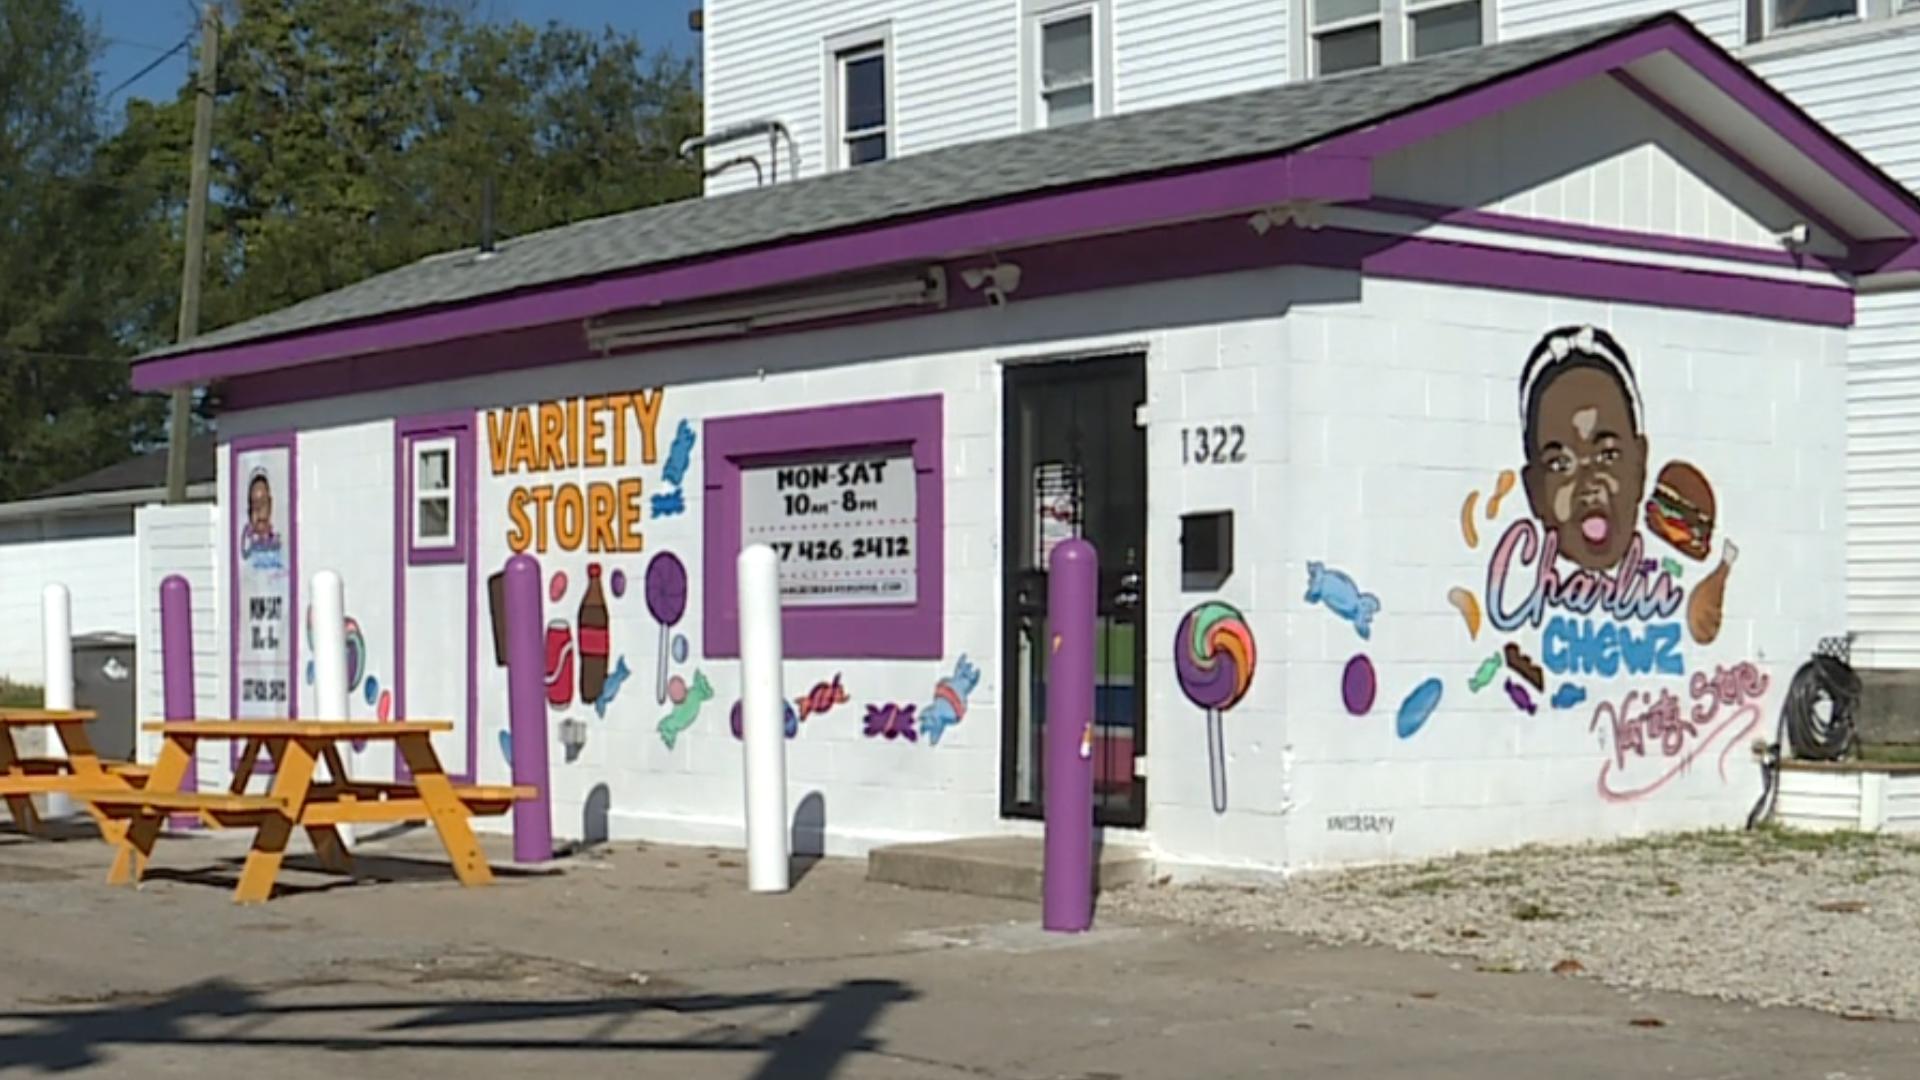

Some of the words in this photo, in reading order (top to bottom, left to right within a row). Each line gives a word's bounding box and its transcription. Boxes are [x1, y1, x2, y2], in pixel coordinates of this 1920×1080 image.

[487, 387, 664, 475] VARIETY
[1181, 424, 1247, 465] 1322
[777, 460, 888, 491] MON-SAT
[507, 477, 643, 553] STORE
[770, 536, 910, 562] 7.426.2412
